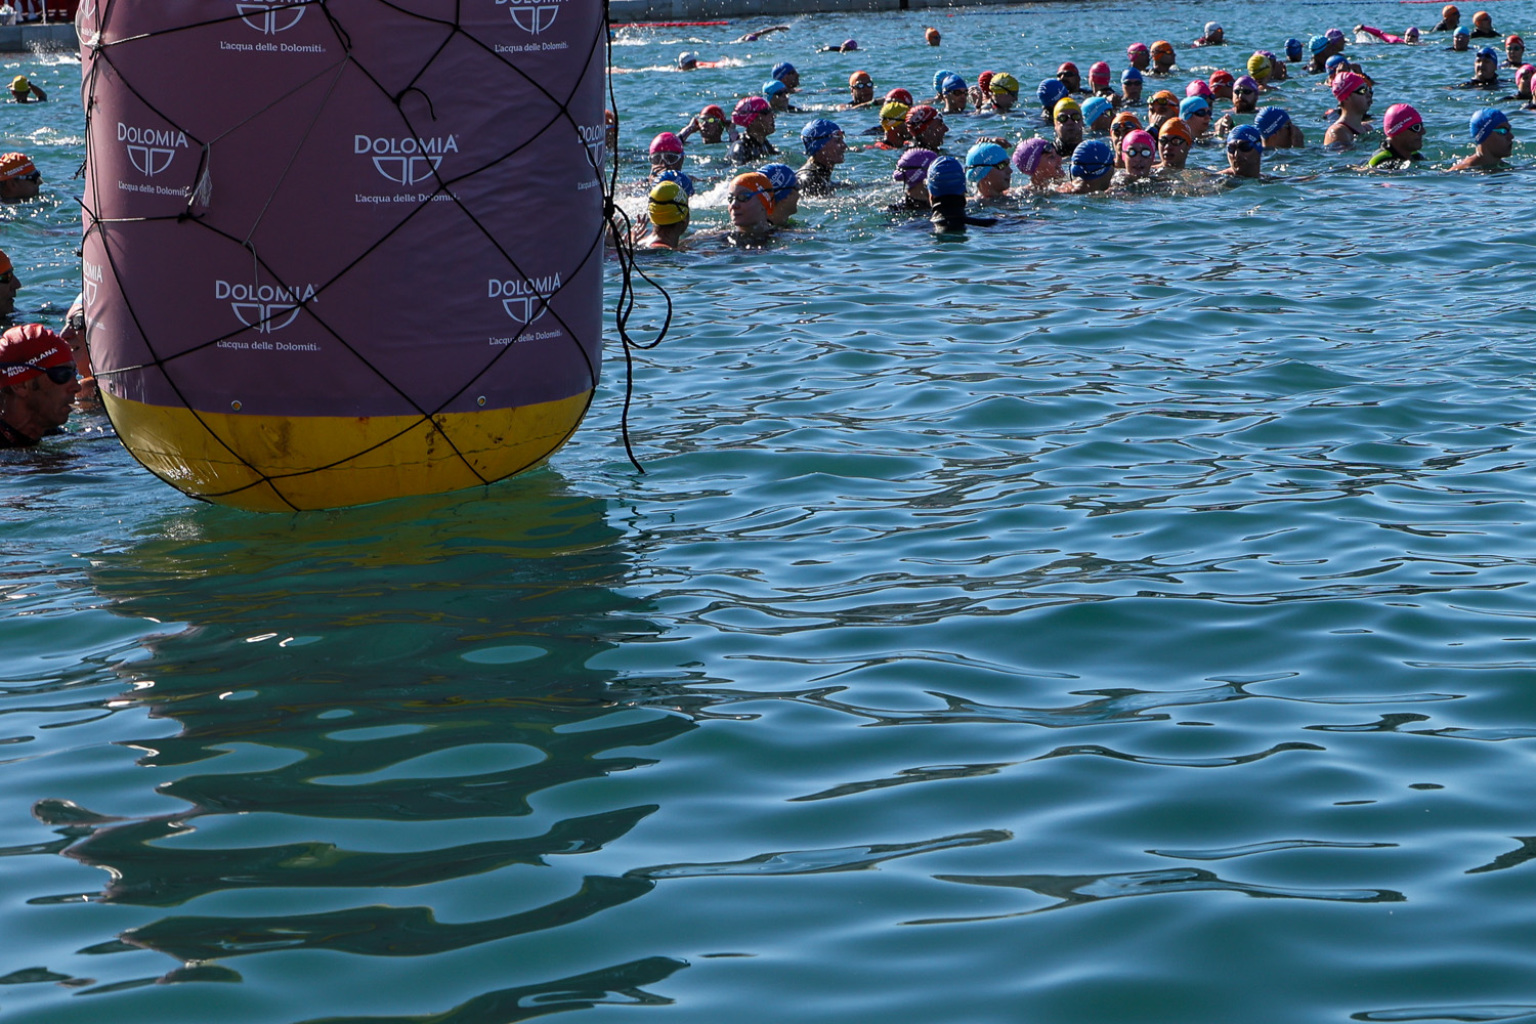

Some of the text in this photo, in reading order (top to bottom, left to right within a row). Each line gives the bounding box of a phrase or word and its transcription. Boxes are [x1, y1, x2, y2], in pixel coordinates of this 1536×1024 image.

[255, 43, 278, 51] delle
[280, 43, 322, 52] Dolomiti
[524, 43, 541, 51] delle
[542, 41, 567, 51] Dolomiti
[117, 122, 188, 148] DOLOMIA
[354, 134, 458, 154] DOLOMIA
[139, 184, 155, 193] delle
[393, 194, 416, 203] delle
[488, 272, 561, 298] DOLOMIA
[215, 280, 319, 303] DOLOMIA
[518, 334, 535, 343] delle
[535, 329, 562, 340] Dolomiti
[251, 341, 273, 350] delle
[276, 342, 317, 351] Dolomiti
